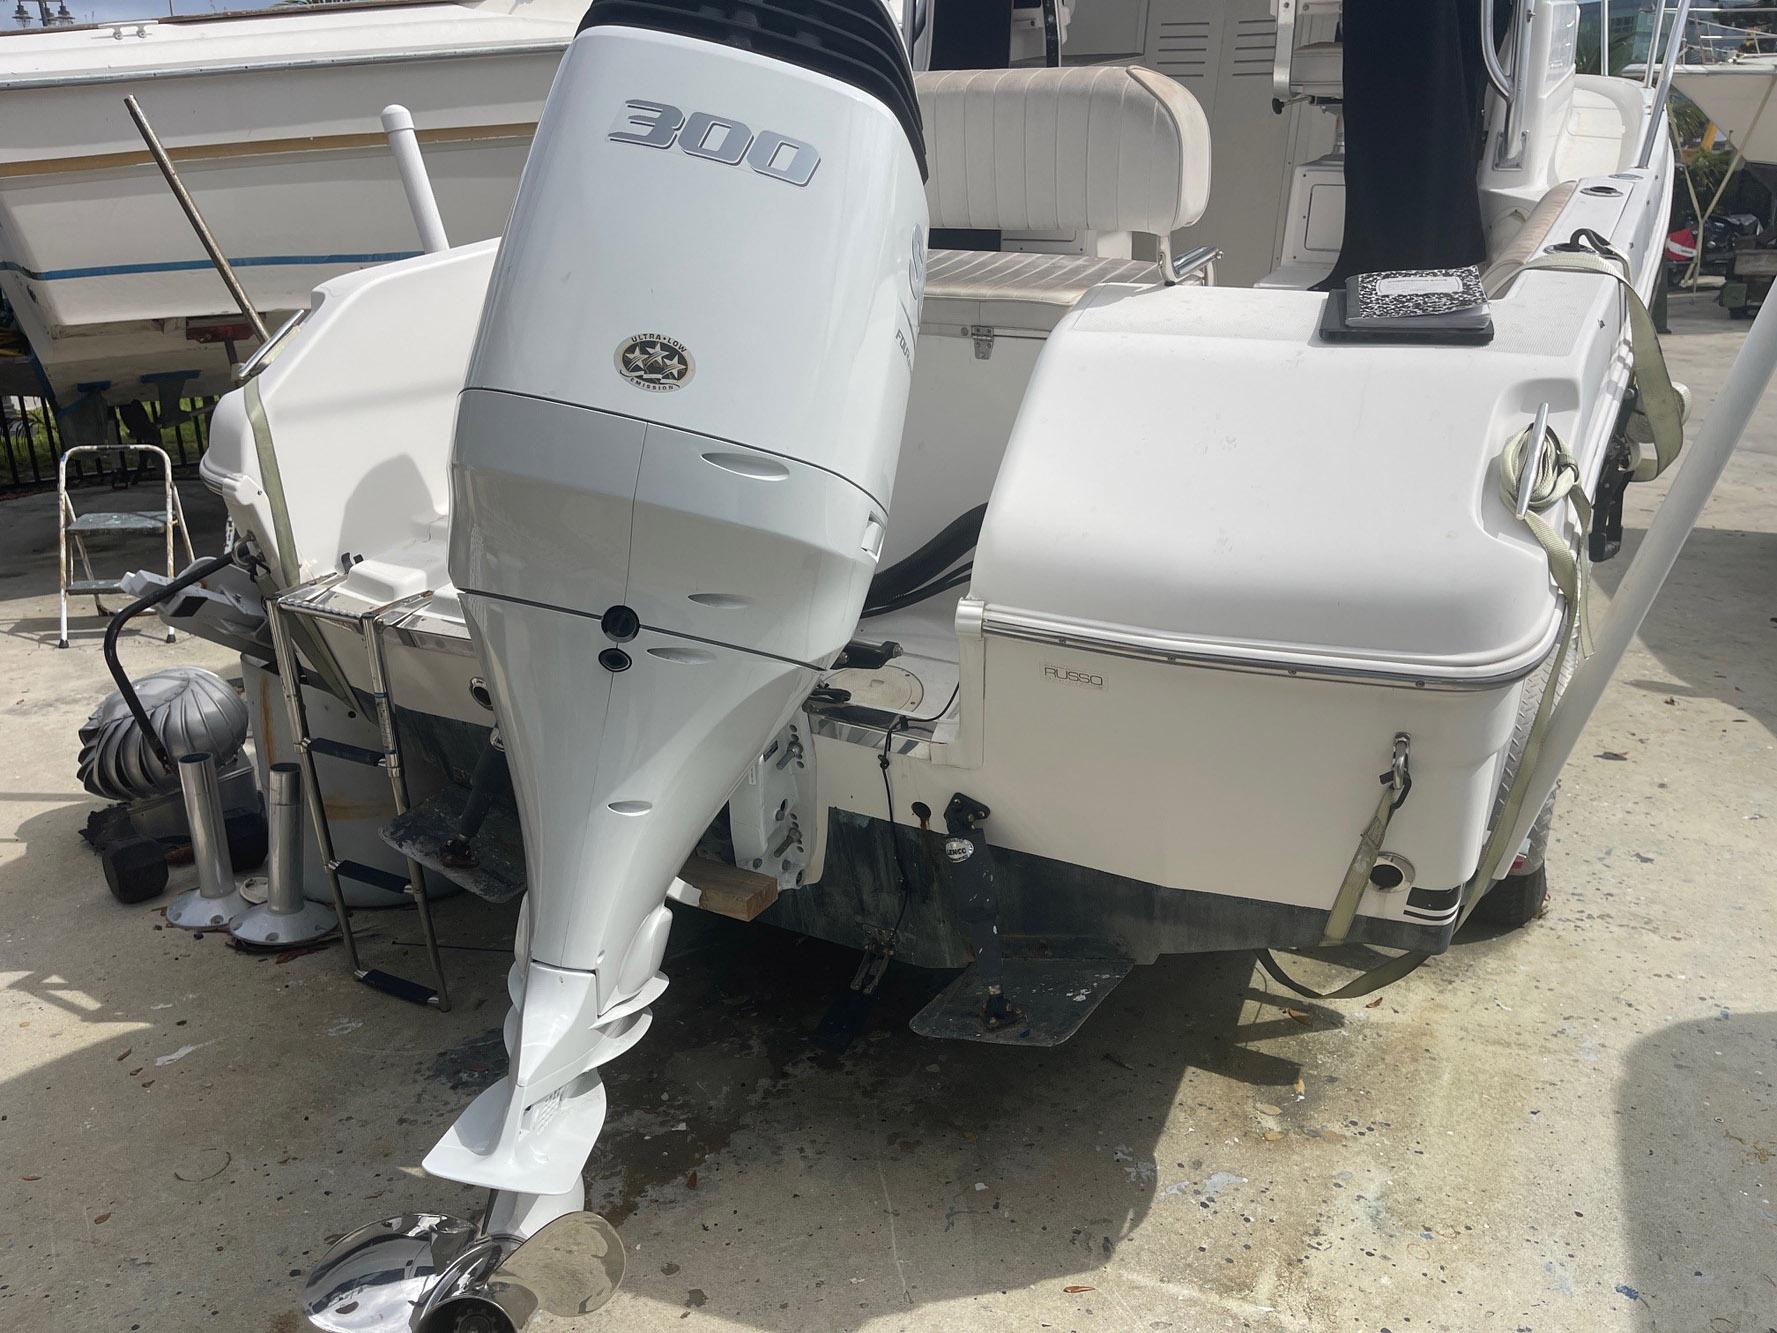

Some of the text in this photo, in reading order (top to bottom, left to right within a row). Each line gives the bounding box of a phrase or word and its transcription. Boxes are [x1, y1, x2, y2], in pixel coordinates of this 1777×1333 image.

[607, 99, 822, 187] 300
[631, 333, 687, 353] ULTRA LOW
[1044, 667, 1103, 686] RUSSO
